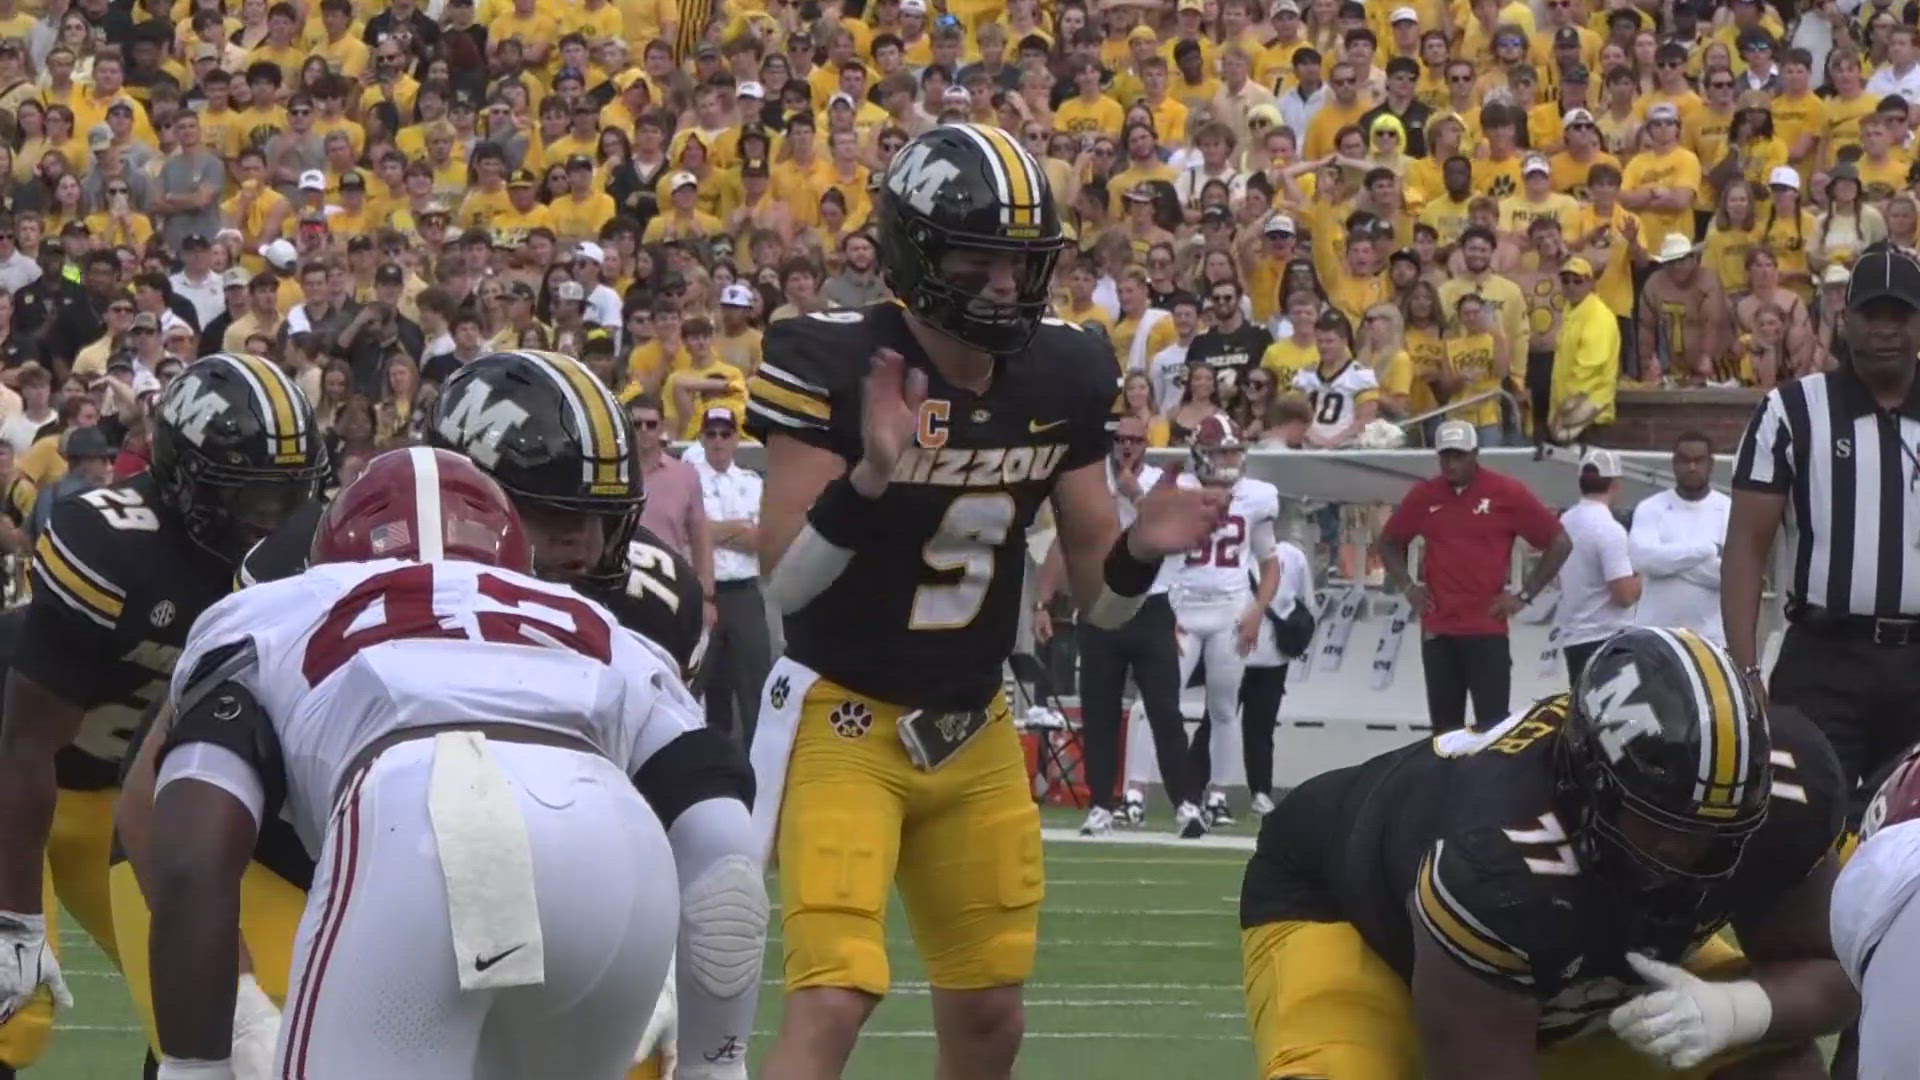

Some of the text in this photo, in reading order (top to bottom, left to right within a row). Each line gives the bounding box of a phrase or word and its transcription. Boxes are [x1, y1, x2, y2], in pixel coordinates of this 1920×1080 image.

[888, 142, 961, 216] M
[163, 374, 231, 448] M
[437, 377, 531, 470] M
[917, 399, 951, 449] C
[1836, 438, 1851, 459] S
[79, 487, 161, 532] 29
[625, 540, 680, 615] 79
[301, 562, 613, 689] 42
[1584, 662, 1663, 766] M
[1501, 811, 1580, 876] 77
